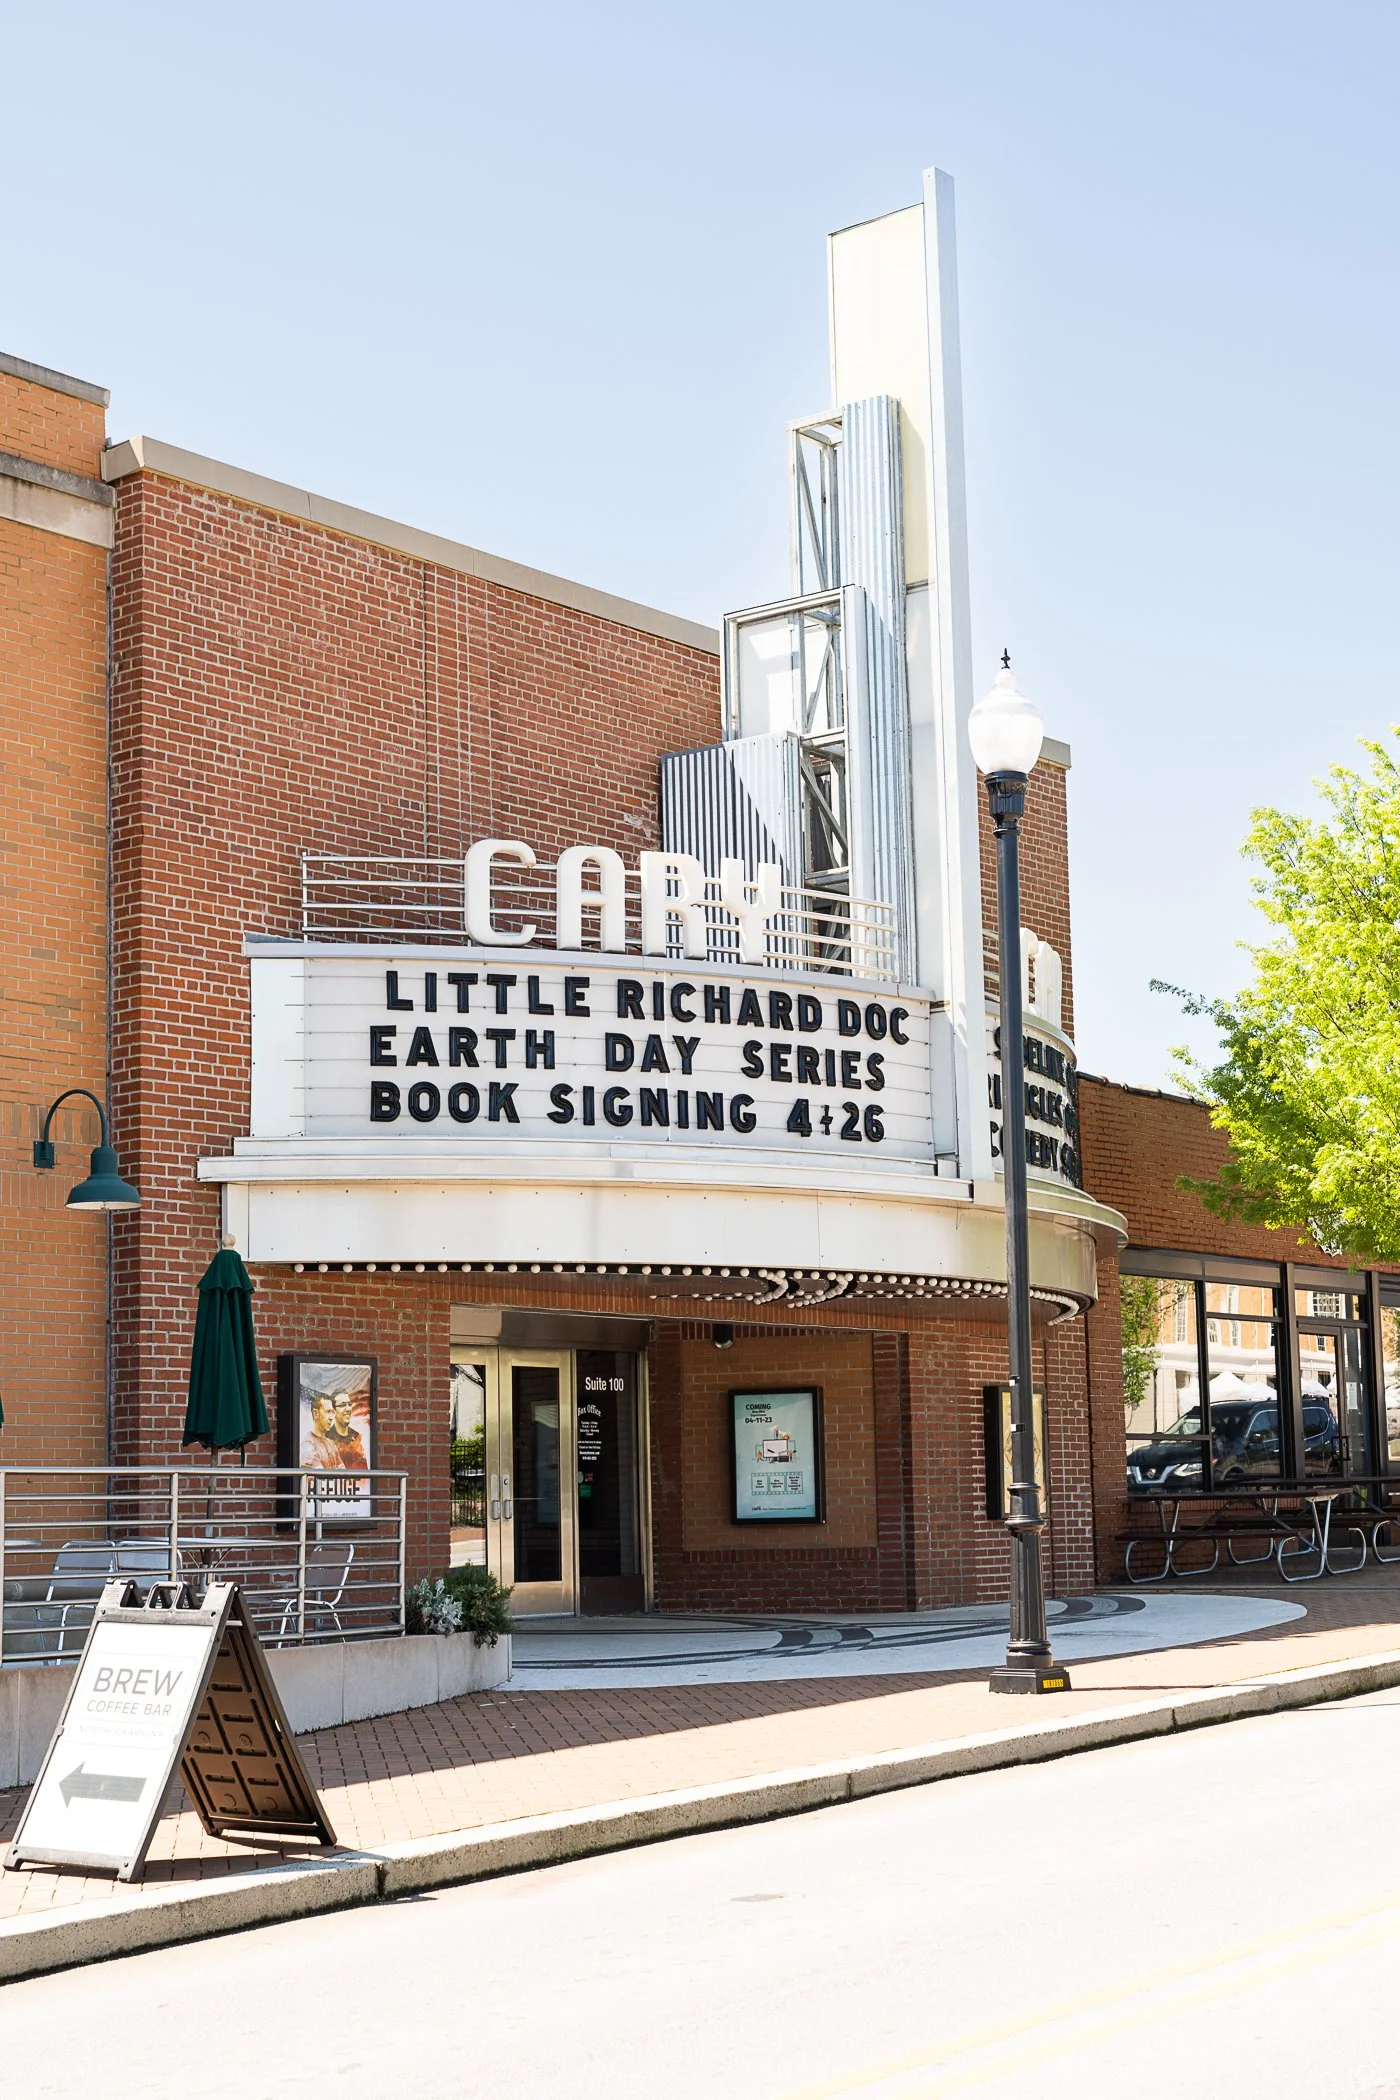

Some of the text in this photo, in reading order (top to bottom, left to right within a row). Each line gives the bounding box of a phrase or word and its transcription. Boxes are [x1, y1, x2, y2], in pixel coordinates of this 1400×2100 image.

[464, 839, 782, 967] CARY
[386, 970, 910, 1045] LITTLE RICHARD DOC
[370, 1025, 886, 1092] EARTH DAY SERIES
[370, 1081, 520, 1123] BOOK
[547, 1083, 757, 1134] SIGNING
[585, 1376, 624, 1391] Suite 100
[586, 1404, 602, 1417] Office
[744, 1416, 773, 1424] 04-11-23
[93, 1667, 184, 1697] BREW
[87, 1699, 172, 1717] COFFEE BAR
